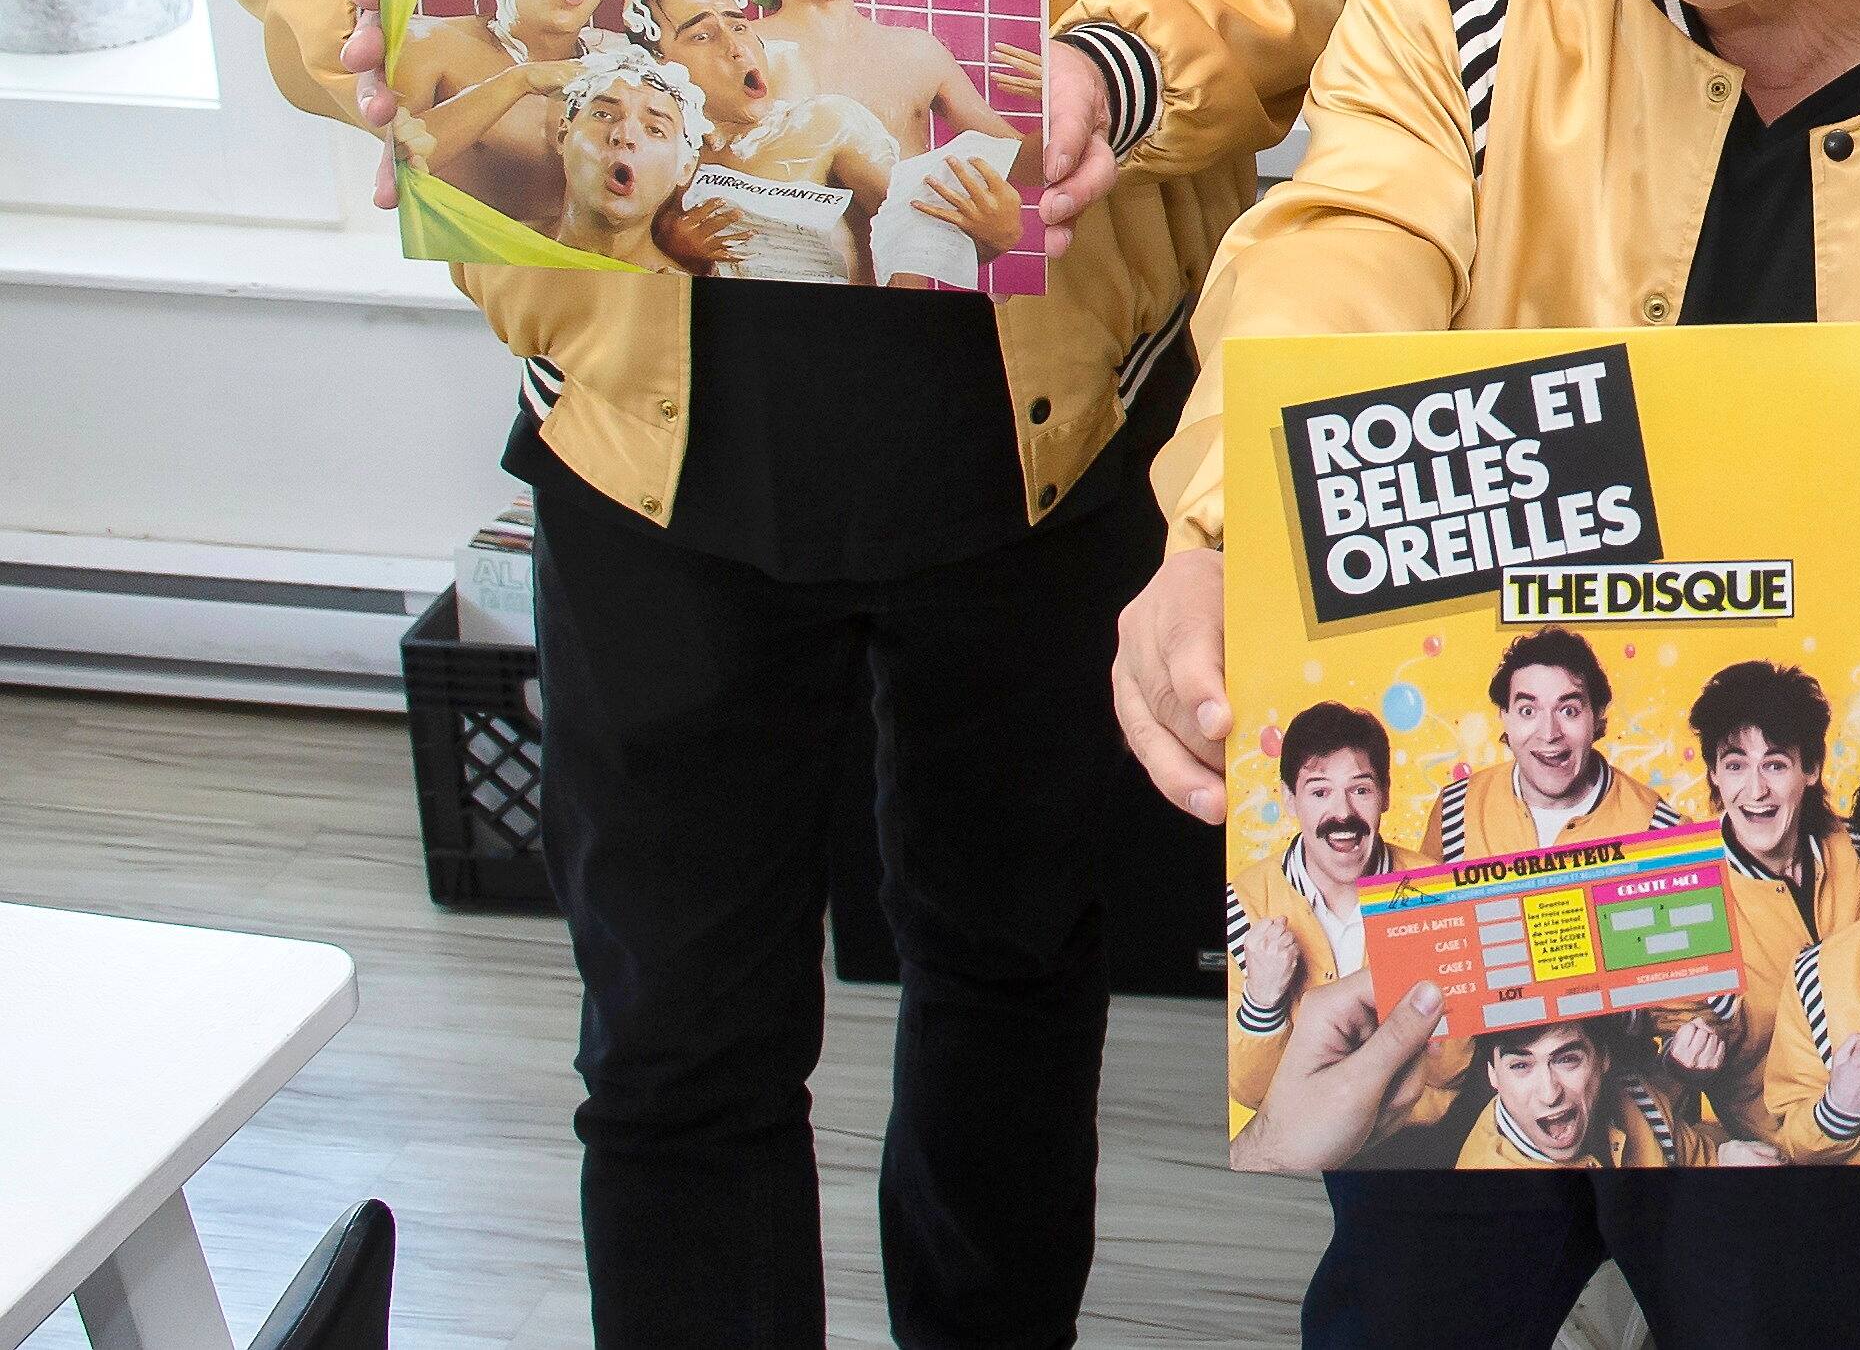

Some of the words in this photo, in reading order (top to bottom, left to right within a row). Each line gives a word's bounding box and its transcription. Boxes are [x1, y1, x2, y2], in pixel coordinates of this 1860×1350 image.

[696, 174, 768, 195] POURQUOI
[768, 186, 844, 205] CHANTER?
[1306, 380, 1516, 476] ROCK
[1530, 361, 1607, 432] ET
[1316, 438, 1550, 537] BELLES
[1326, 484, 1642, 596] OREILLES
[1509, 574, 1599, 617] THE
[1606, 568, 1789, 614] DISQUE
[1452, 841, 1626, 887] LOTO-GRATTEUX
[1434, 939, 1464, 953] CASE
[1438, 962, 1467, 975] CASE
[1498, 987, 1524, 1002] LOT
